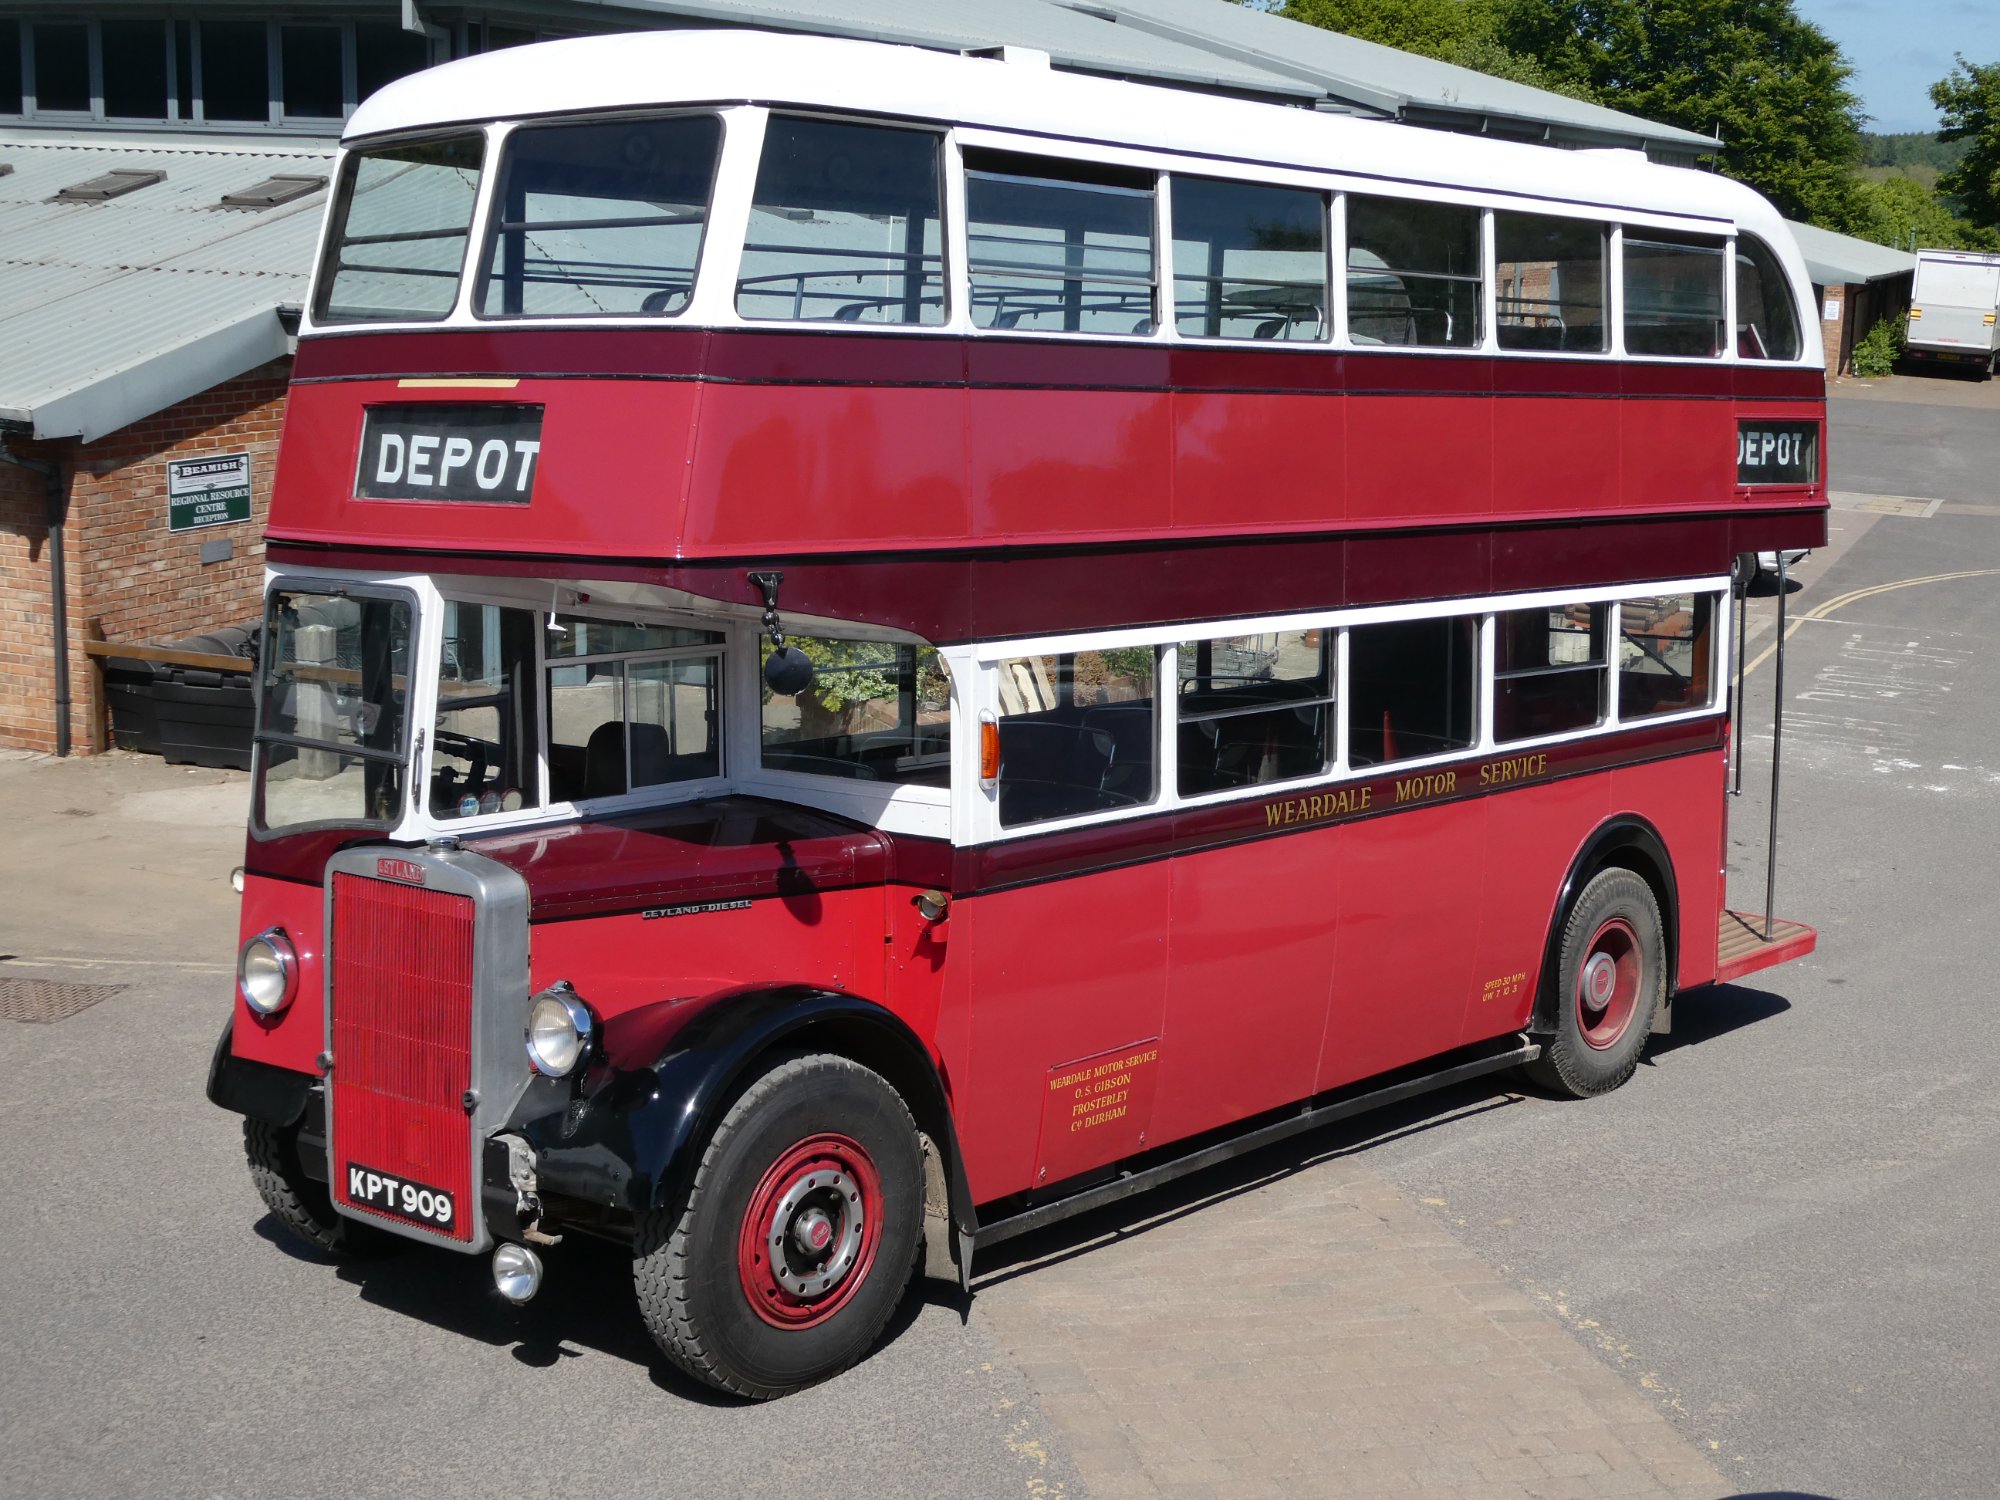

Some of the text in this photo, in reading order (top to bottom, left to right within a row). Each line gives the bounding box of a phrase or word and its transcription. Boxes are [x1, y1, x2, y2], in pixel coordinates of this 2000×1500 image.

[182, 462, 237, 476] BEAMISH
[376, 434, 540, 491] DEPOT
[171, 488, 249, 506] REGIONAL RESOURCE
[195, 502, 227, 514] CENTRE
[193, 512, 229, 524] RECEPTION
[1265, 753, 1547, 827] WEARDALE MOTOR SERVICE
[708, 900, 752, 911] DIESEL
[1484, 979, 1502, 991] SPEED
[1050, 1050, 1157, 1091] WEARDALE MOTOR SERVICE
[1094, 1073, 1131, 1093] GIBSON
[1072, 1090, 1128, 1117] FROSTERLEY
[1085, 1106, 1127, 1128] DURHAM
